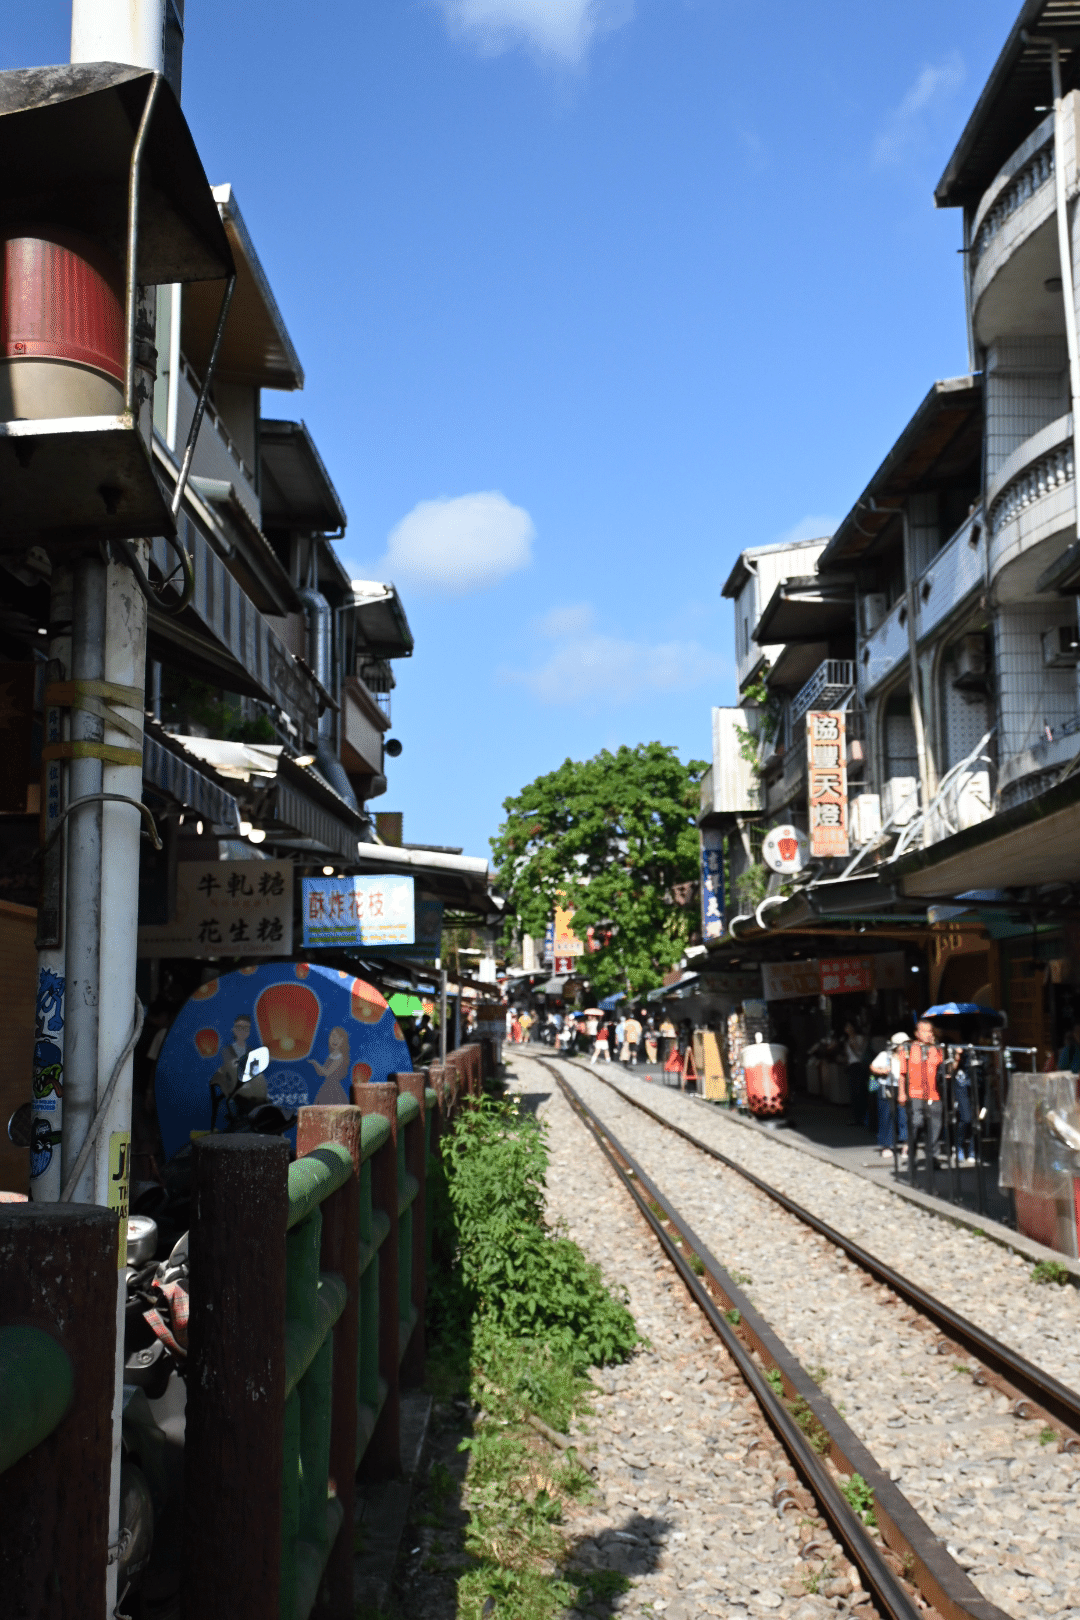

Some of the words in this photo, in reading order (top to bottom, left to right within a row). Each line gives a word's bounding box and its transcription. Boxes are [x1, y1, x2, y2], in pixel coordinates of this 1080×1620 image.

[813, 716, 841, 827] 協豐天燈
[198, 871, 284, 897] 牛軋糖
[309, 889, 383, 919] 酥炸花枝
[198, 916, 283, 943] 花生糖
